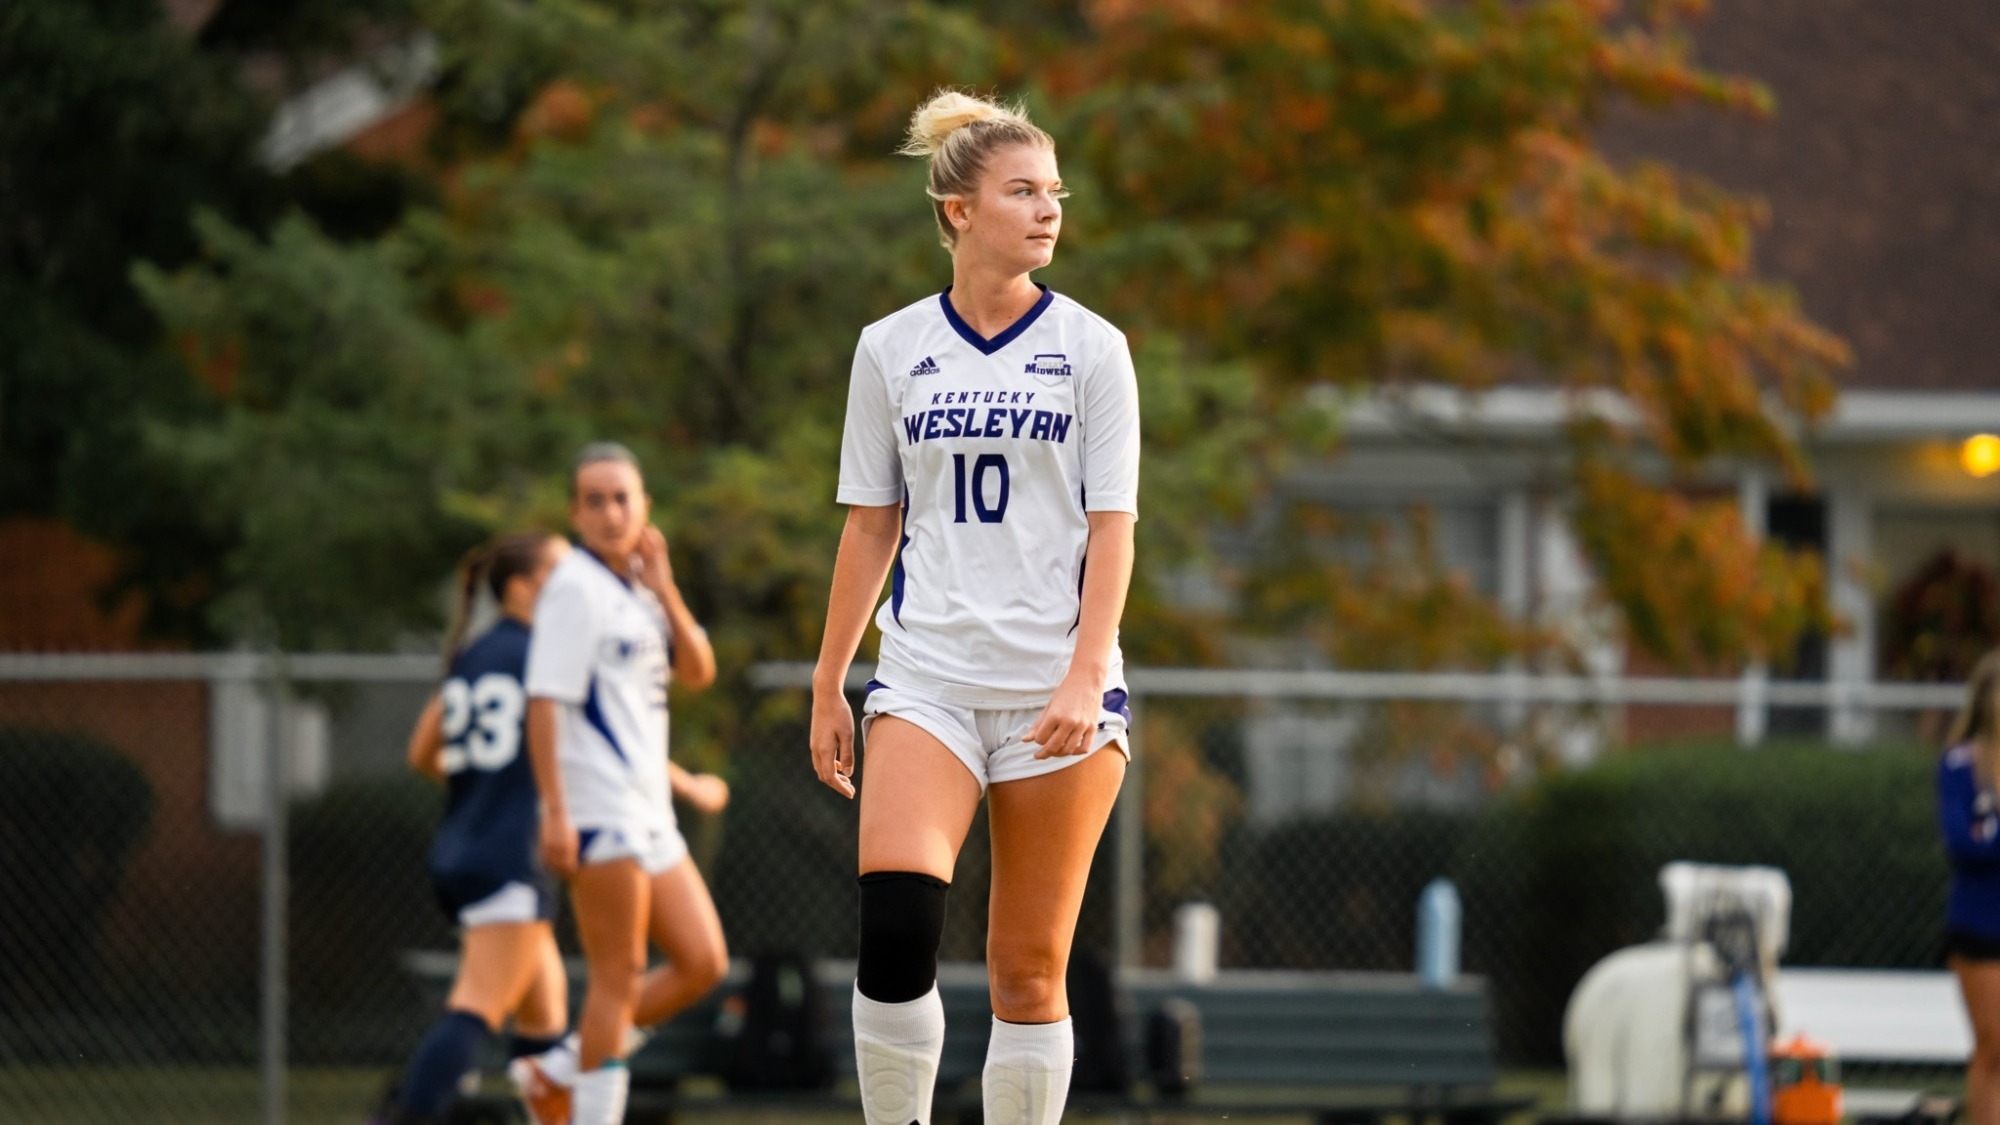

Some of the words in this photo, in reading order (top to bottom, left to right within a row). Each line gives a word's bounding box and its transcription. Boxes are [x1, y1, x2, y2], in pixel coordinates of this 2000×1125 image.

[910, 366, 941, 377] adidas
[1024, 363, 1072, 376] MIDWEST
[931, 391, 1036, 405] KENTUCKY
[903, 408, 1073, 446] WESLEYAN
[952, 453, 1010, 523] 10
[439, 672, 527, 774] 23
